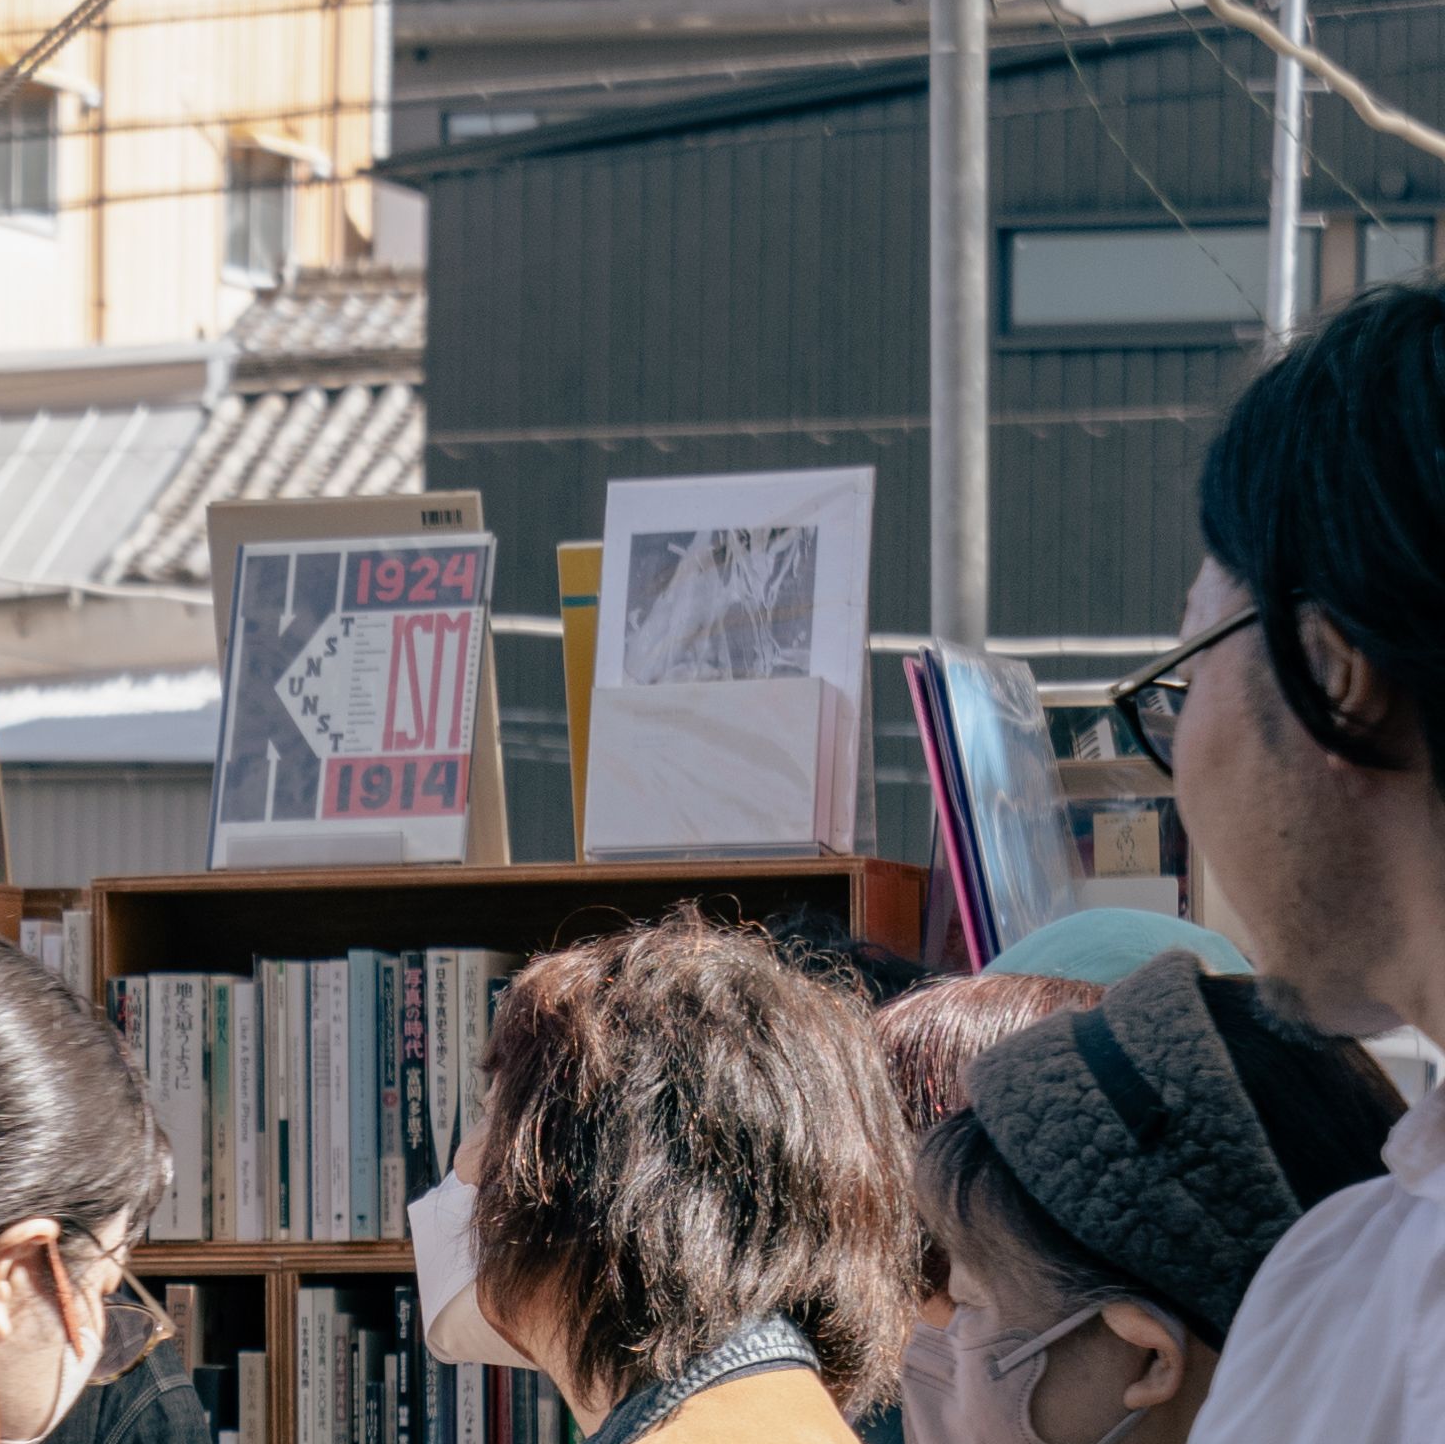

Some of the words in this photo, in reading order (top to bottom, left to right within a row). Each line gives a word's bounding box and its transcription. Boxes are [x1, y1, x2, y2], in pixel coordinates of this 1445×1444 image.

[357, 554, 476, 604] 1924
[381, 611, 472, 753] ISM
[336, 761, 458, 812] 1914
